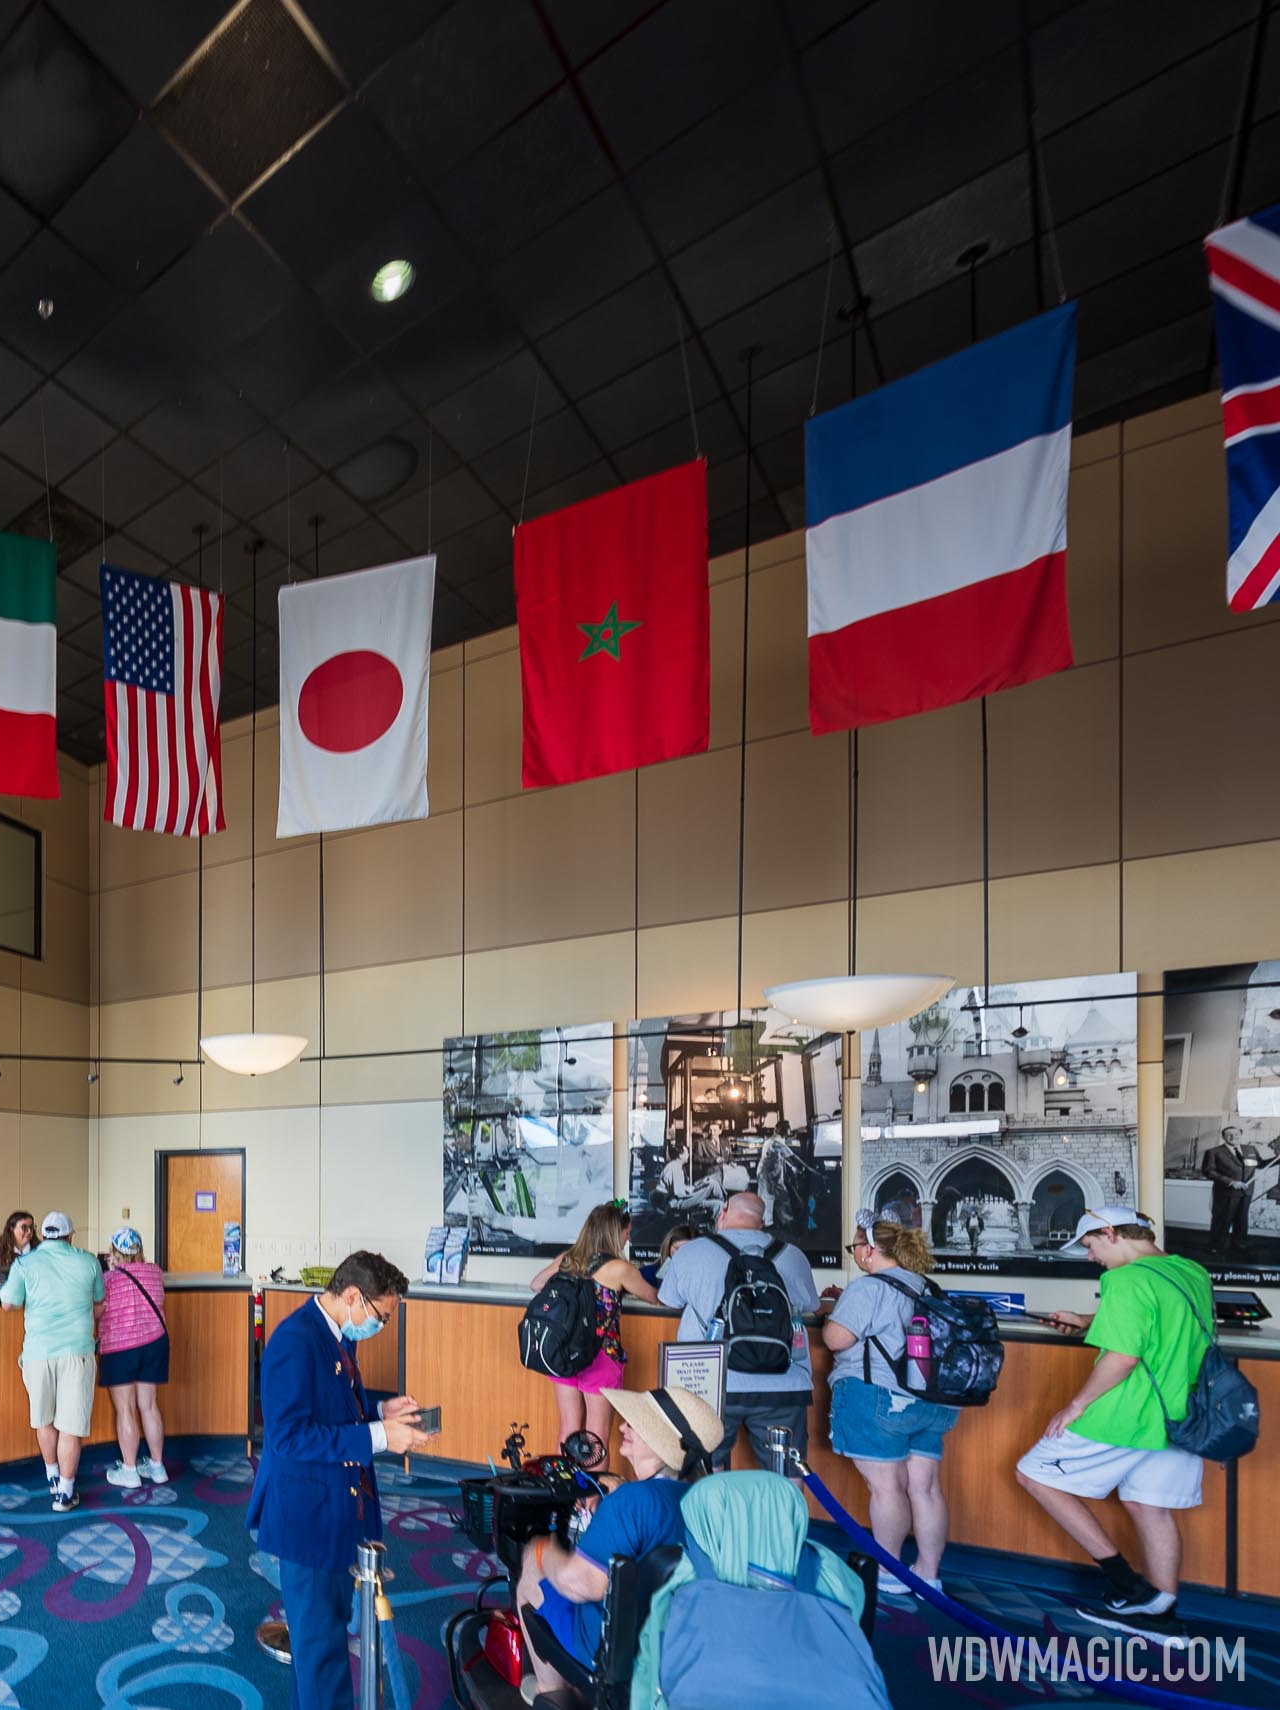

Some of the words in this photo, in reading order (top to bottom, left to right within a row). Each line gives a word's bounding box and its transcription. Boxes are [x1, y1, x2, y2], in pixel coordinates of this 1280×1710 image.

[947, 1261, 976, 1271] Beauty's
[978, 1262, 999, 1271] Castle
[1224, 1271, 1260, 1283] planning
[1262, 1273, 1280, 1281] Wal
